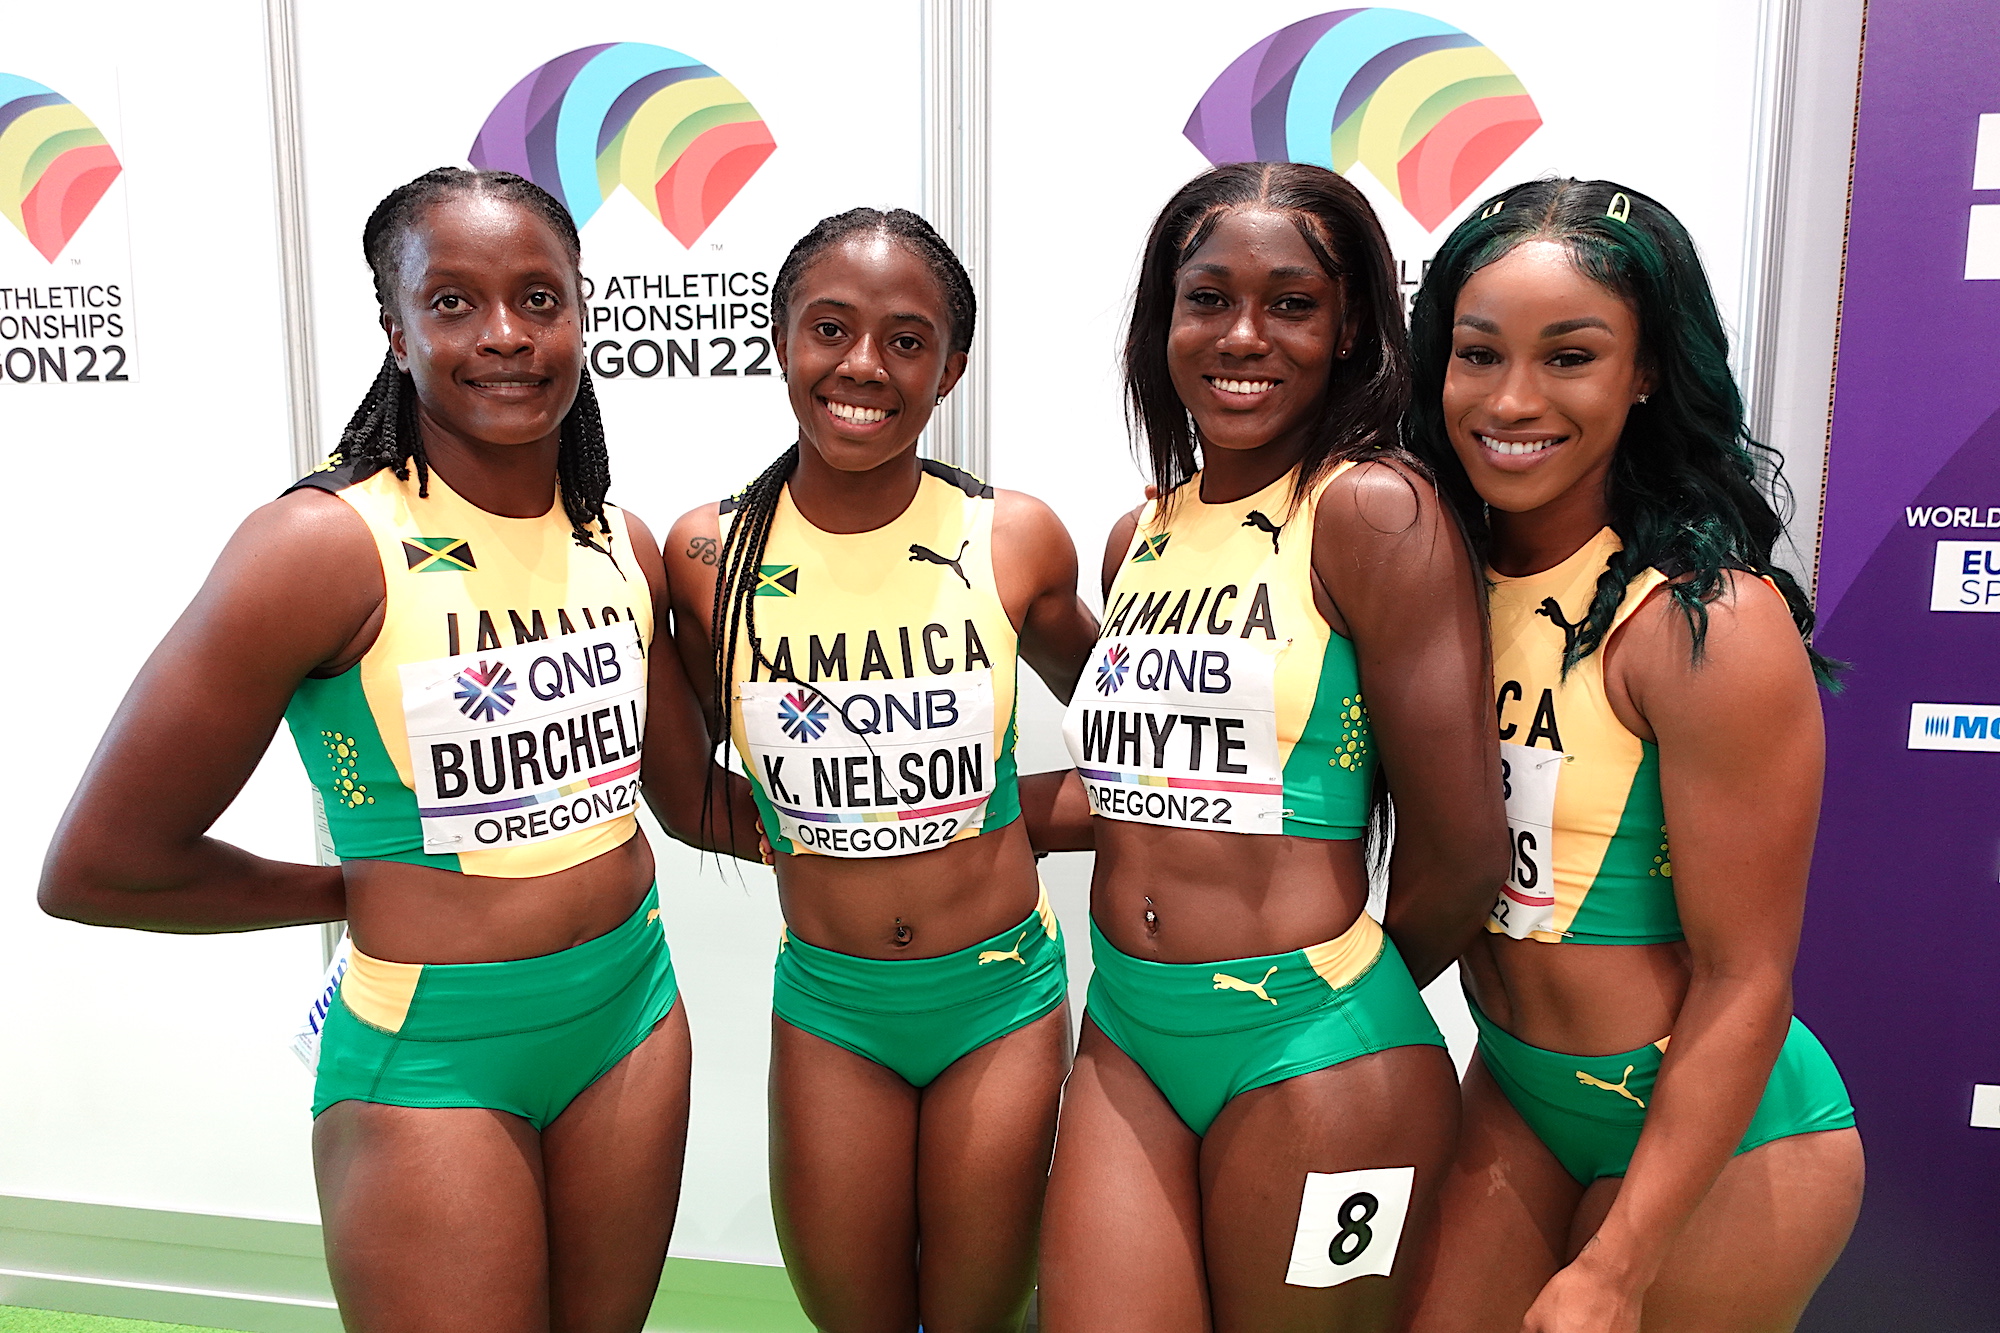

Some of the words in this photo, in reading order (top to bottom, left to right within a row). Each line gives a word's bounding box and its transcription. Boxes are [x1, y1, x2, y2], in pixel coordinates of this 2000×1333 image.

[0, 285, 122, 311] THLETICS
[604, 271, 770, 300] ATHLETICS
[585, 302, 770, 333] PIONSHIPS
[0, 344, 129, 383] ON22
[583, 336, 772, 379] GON22
[528, 641, 623, 702] QNB
[1136, 647, 1232, 694] QNB
[841, 688, 959, 735] QNB
[430, 700, 643, 800] BURCHELL
[1082, 709, 1248, 775] WHYTE
[762, 754, 801, 806] K.
[812, 742, 984, 808] NELSON
[797, 818, 959, 852] OREGON22
[1328, 1191, 1379, 1266] 8
